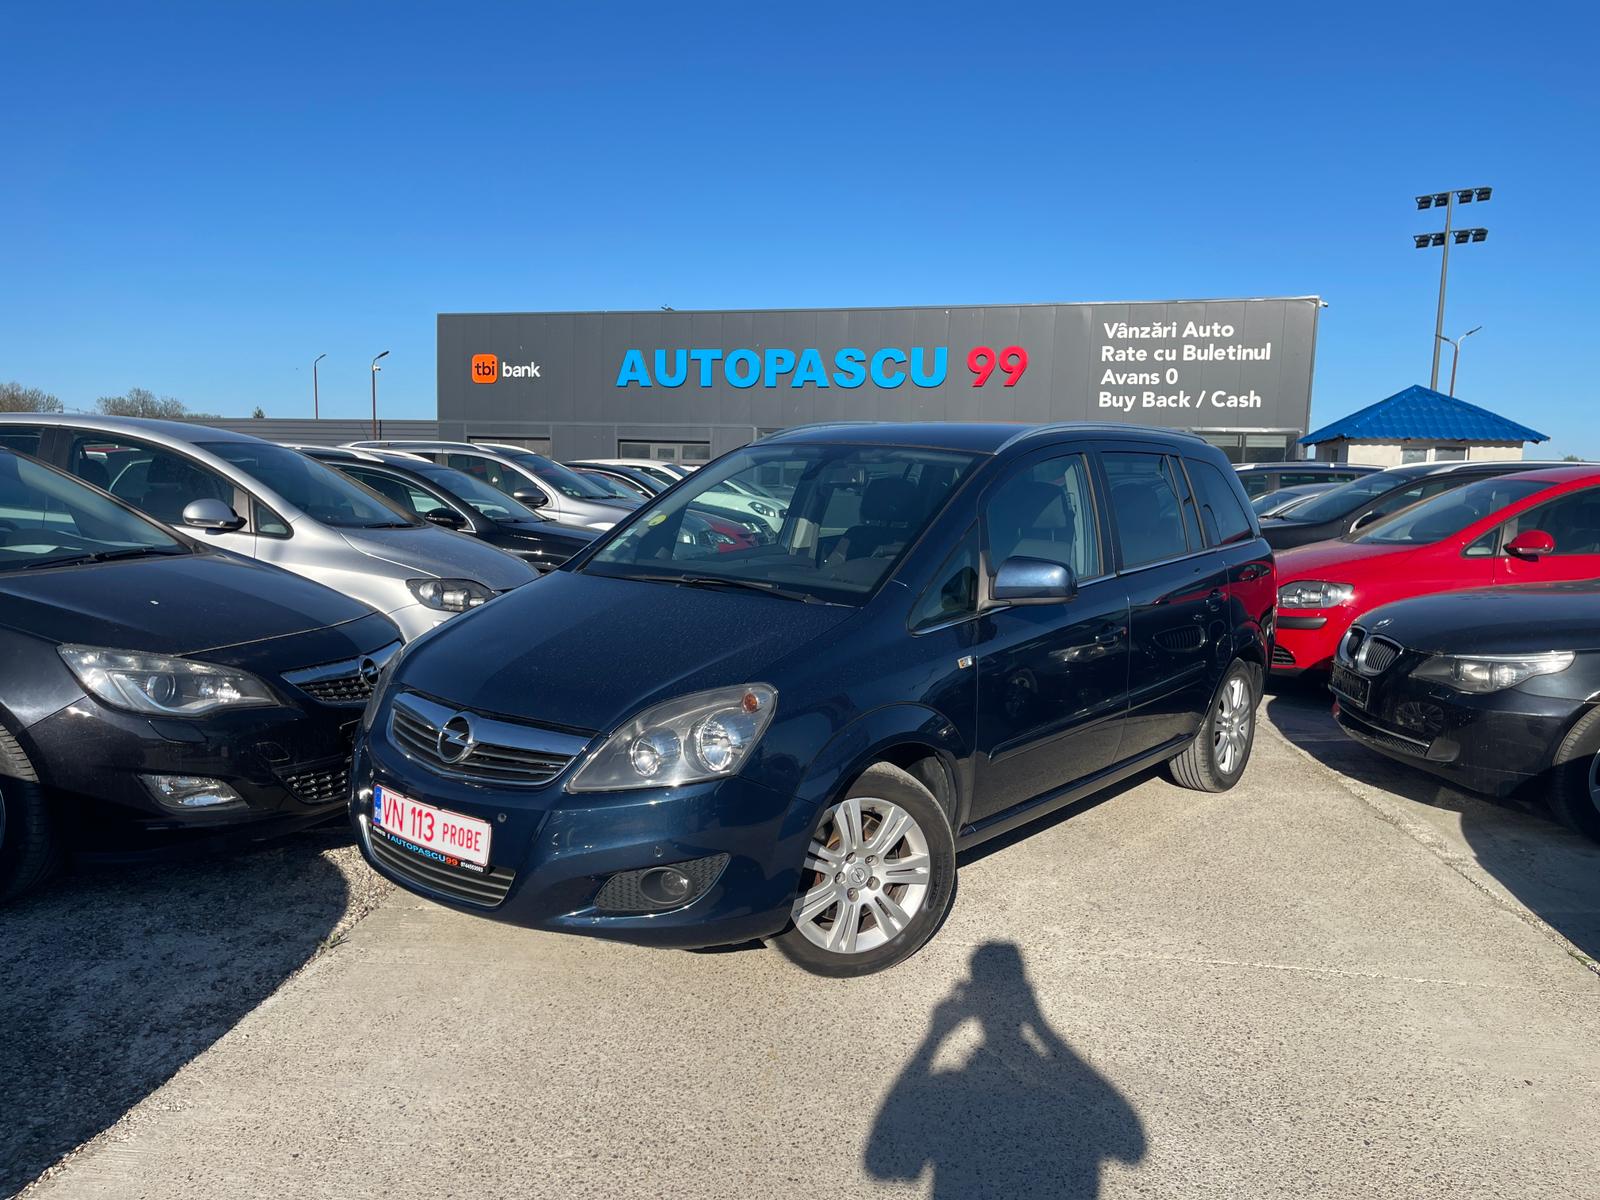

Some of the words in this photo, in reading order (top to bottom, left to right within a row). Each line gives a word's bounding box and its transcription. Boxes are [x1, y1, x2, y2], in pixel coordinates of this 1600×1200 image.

[1103, 322, 1177, 339] Vânzări
[1182, 321, 1235, 338] Auto
[1101, 346, 1147, 362] Rate
[1153, 349, 1177, 361] cu
[1183, 343, 1271, 361] Buletinul
[475, 361, 495, 376] tbi
[502, 362, 541, 377] bank
[616, 346, 948, 388] AUTOPASCU
[966, 345, 1029, 387] 99
[1101, 368, 1160, 385] Avans
[1099, 391, 1136, 411] Buy
[1142, 391, 1191, 408] Back
[1196, 391, 1206, 408] /
[1211, 390, 1262, 408] Cash
[383, 794, 405, 832] VN
[411, 806, 436, 843] 113
[442, 822, 482, 852] PROBE
